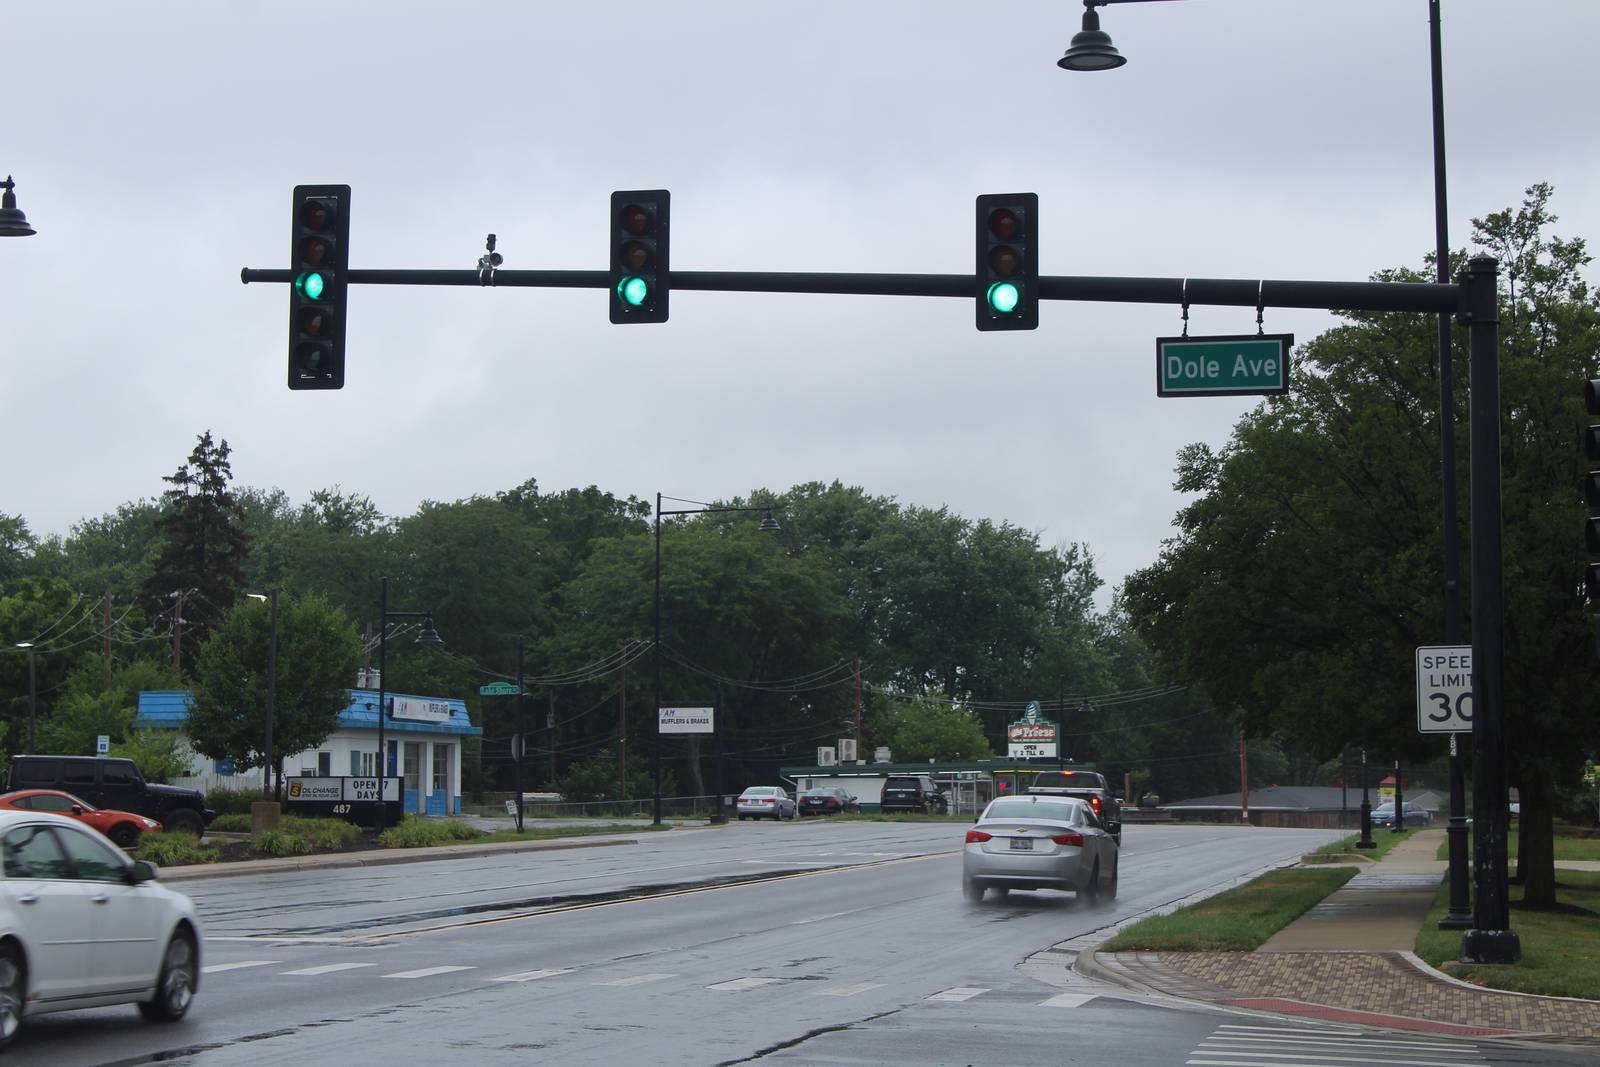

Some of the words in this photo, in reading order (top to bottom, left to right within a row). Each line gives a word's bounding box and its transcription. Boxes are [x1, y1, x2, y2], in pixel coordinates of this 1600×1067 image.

[1167, 355, 1220, 379] Dole
[1231, 353, 1277, 377] Ave
[1423, 656, 1472, 669] SPEE
[1428, 692, 1473, 722] 30
[353, 780, 376, 789] OPEN
[383, 780, 389, 790] 7
[356, 790, 381, 800] DAYS
[333, 804, 351, 813] 487
